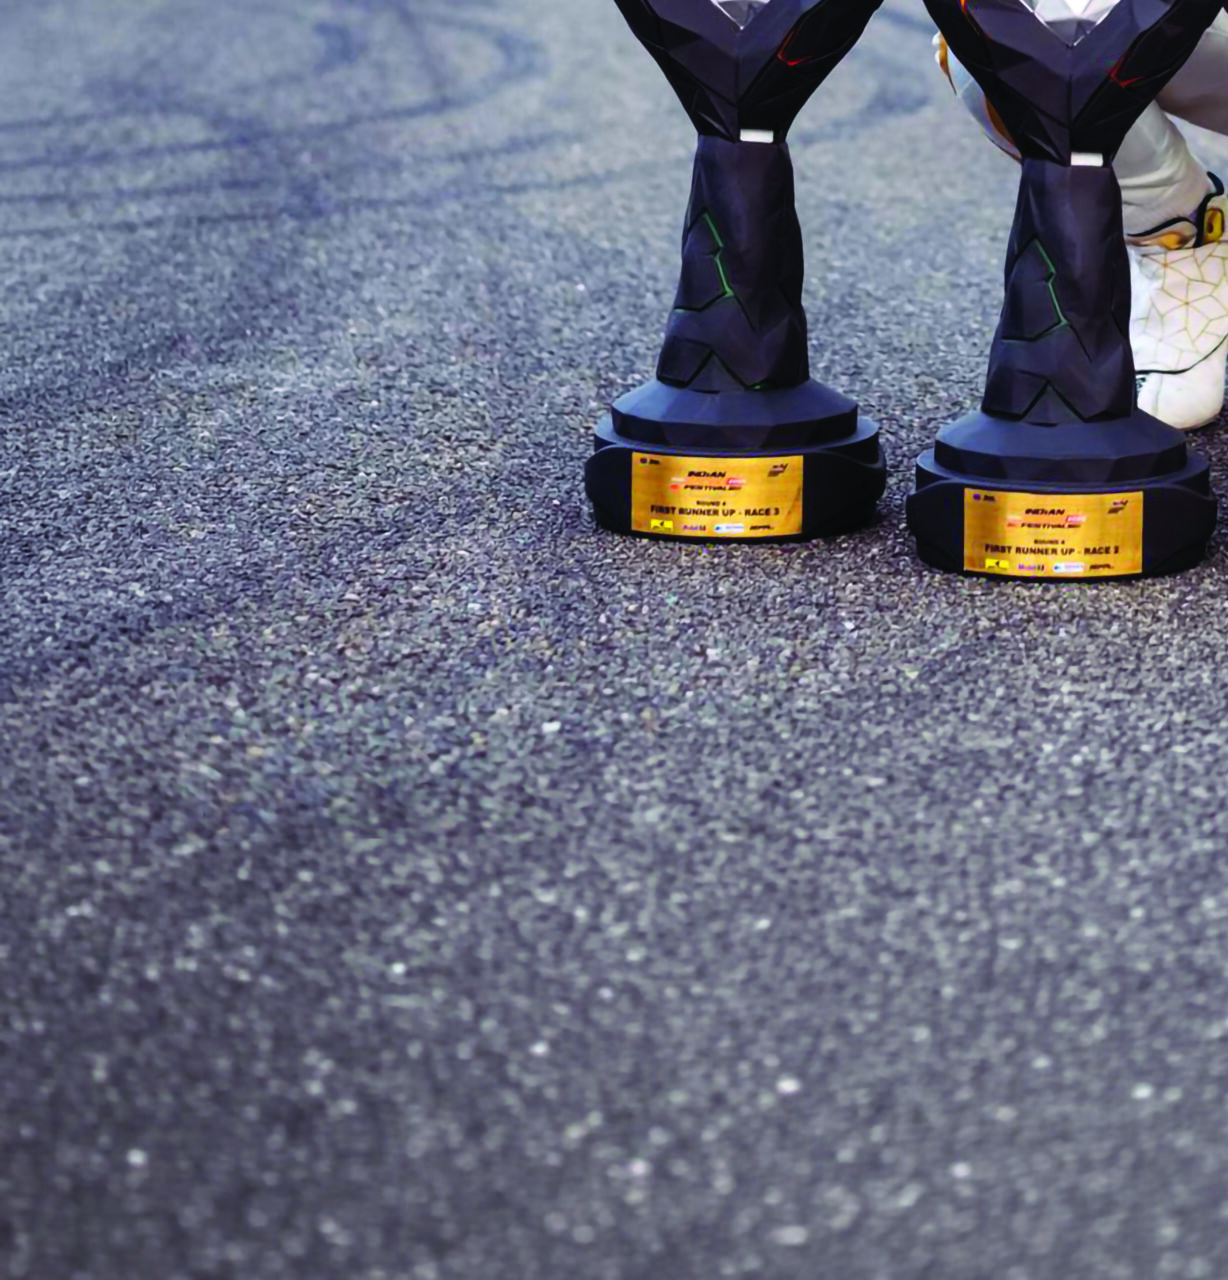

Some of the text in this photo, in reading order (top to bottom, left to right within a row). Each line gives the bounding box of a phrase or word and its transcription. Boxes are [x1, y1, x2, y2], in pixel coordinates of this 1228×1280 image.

[650, 505, 676, 515] FIRST
[678, 507, 720, 517] RUNNER
[722, 509, 736, 517] UP
[744, 508, 771, 516] RACE
[773, 507, 780, 516] 3
[984, 544, 1012, 554] FIRST
[1015, 546, 1058, 556] RUNNER
[1060, 548, 1076, 556] UP
[1083, 546, 1111, 555] RACE
